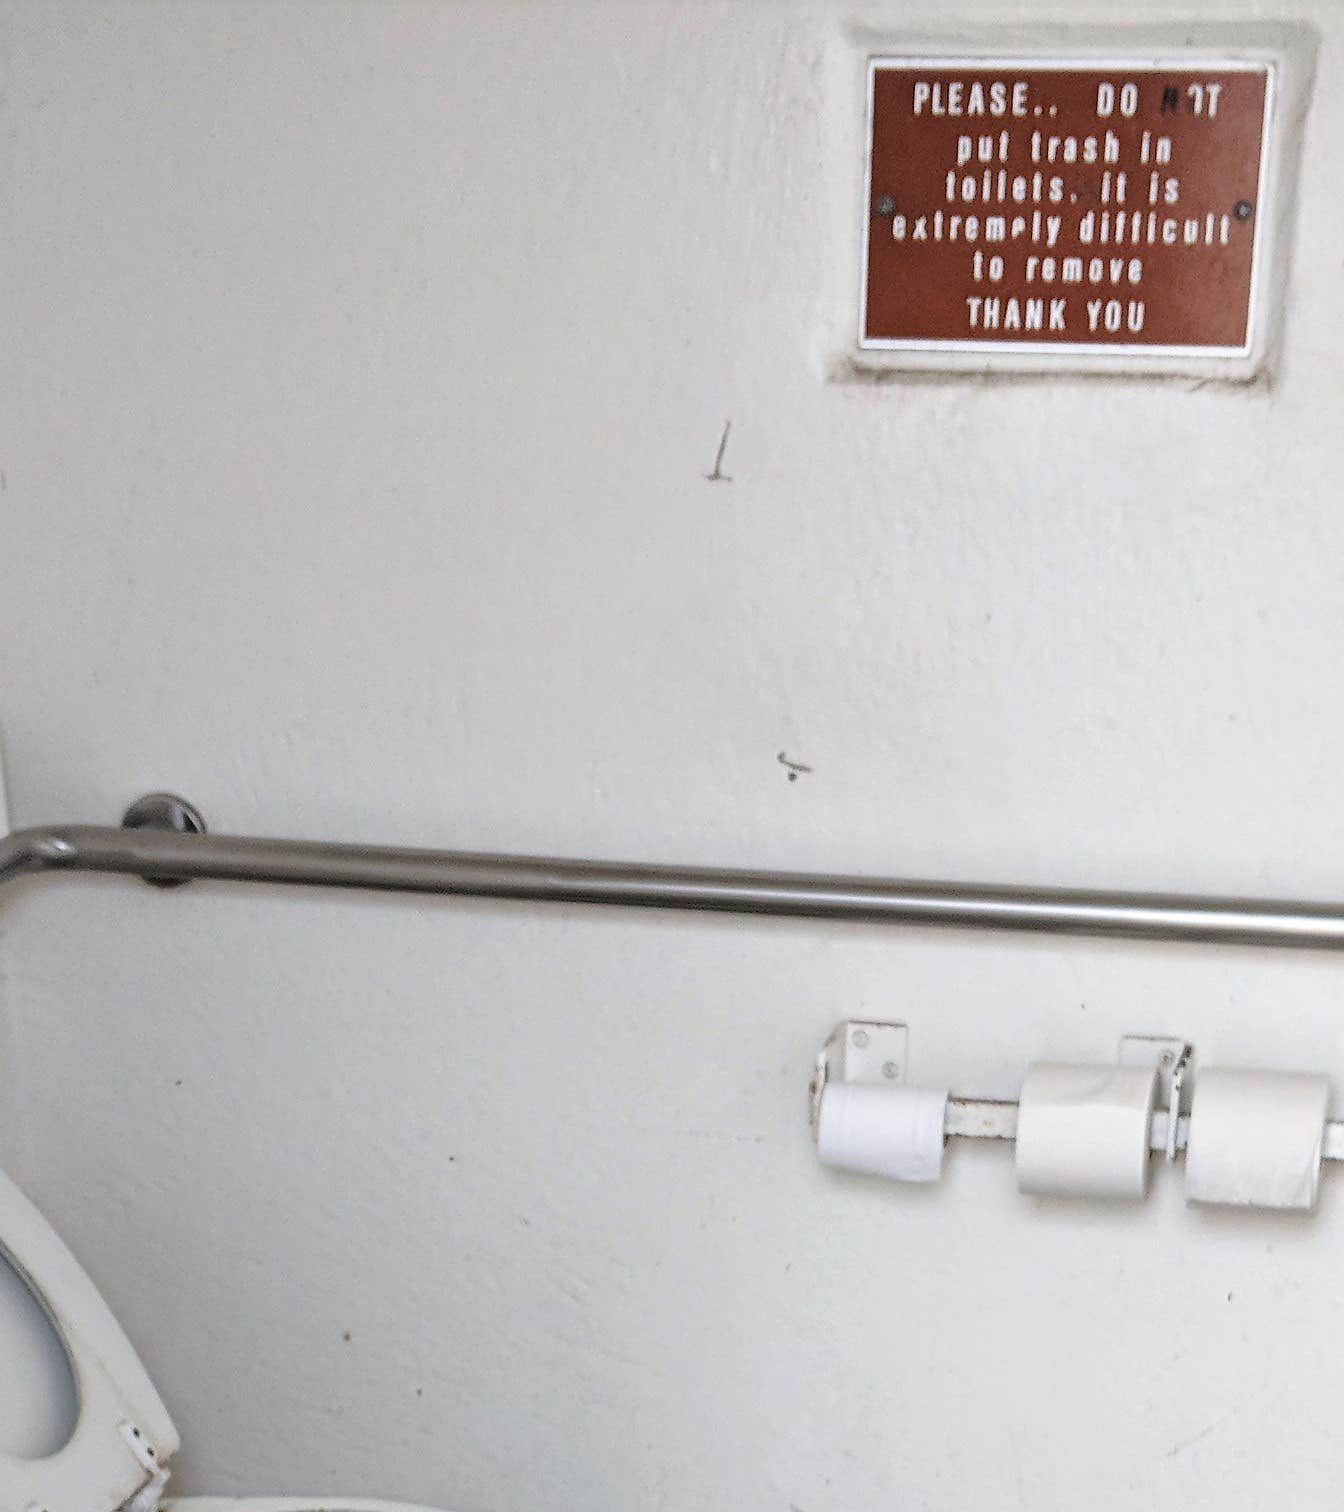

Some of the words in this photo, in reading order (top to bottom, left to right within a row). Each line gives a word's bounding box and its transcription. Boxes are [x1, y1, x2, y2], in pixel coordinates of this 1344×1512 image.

[1096, 82, 1139, 118] DO
[956, 130, 1009, 165] put
[1032, 130, 1120, 163] trash
[1142, 131, 1172, 163] in
[1101, 170, 1127, 204] it
[1149, 171, 1180, 204] is
[892, 210, 1062, 247] extremely
[1079, 211, 1231, 246] difficult
[973, 250, 1004, 281] to
[1027, 255, 1143, 283] remove
[966, 296, 1066, 331] THANK
[1088, 299, 1146, 331] YOU
